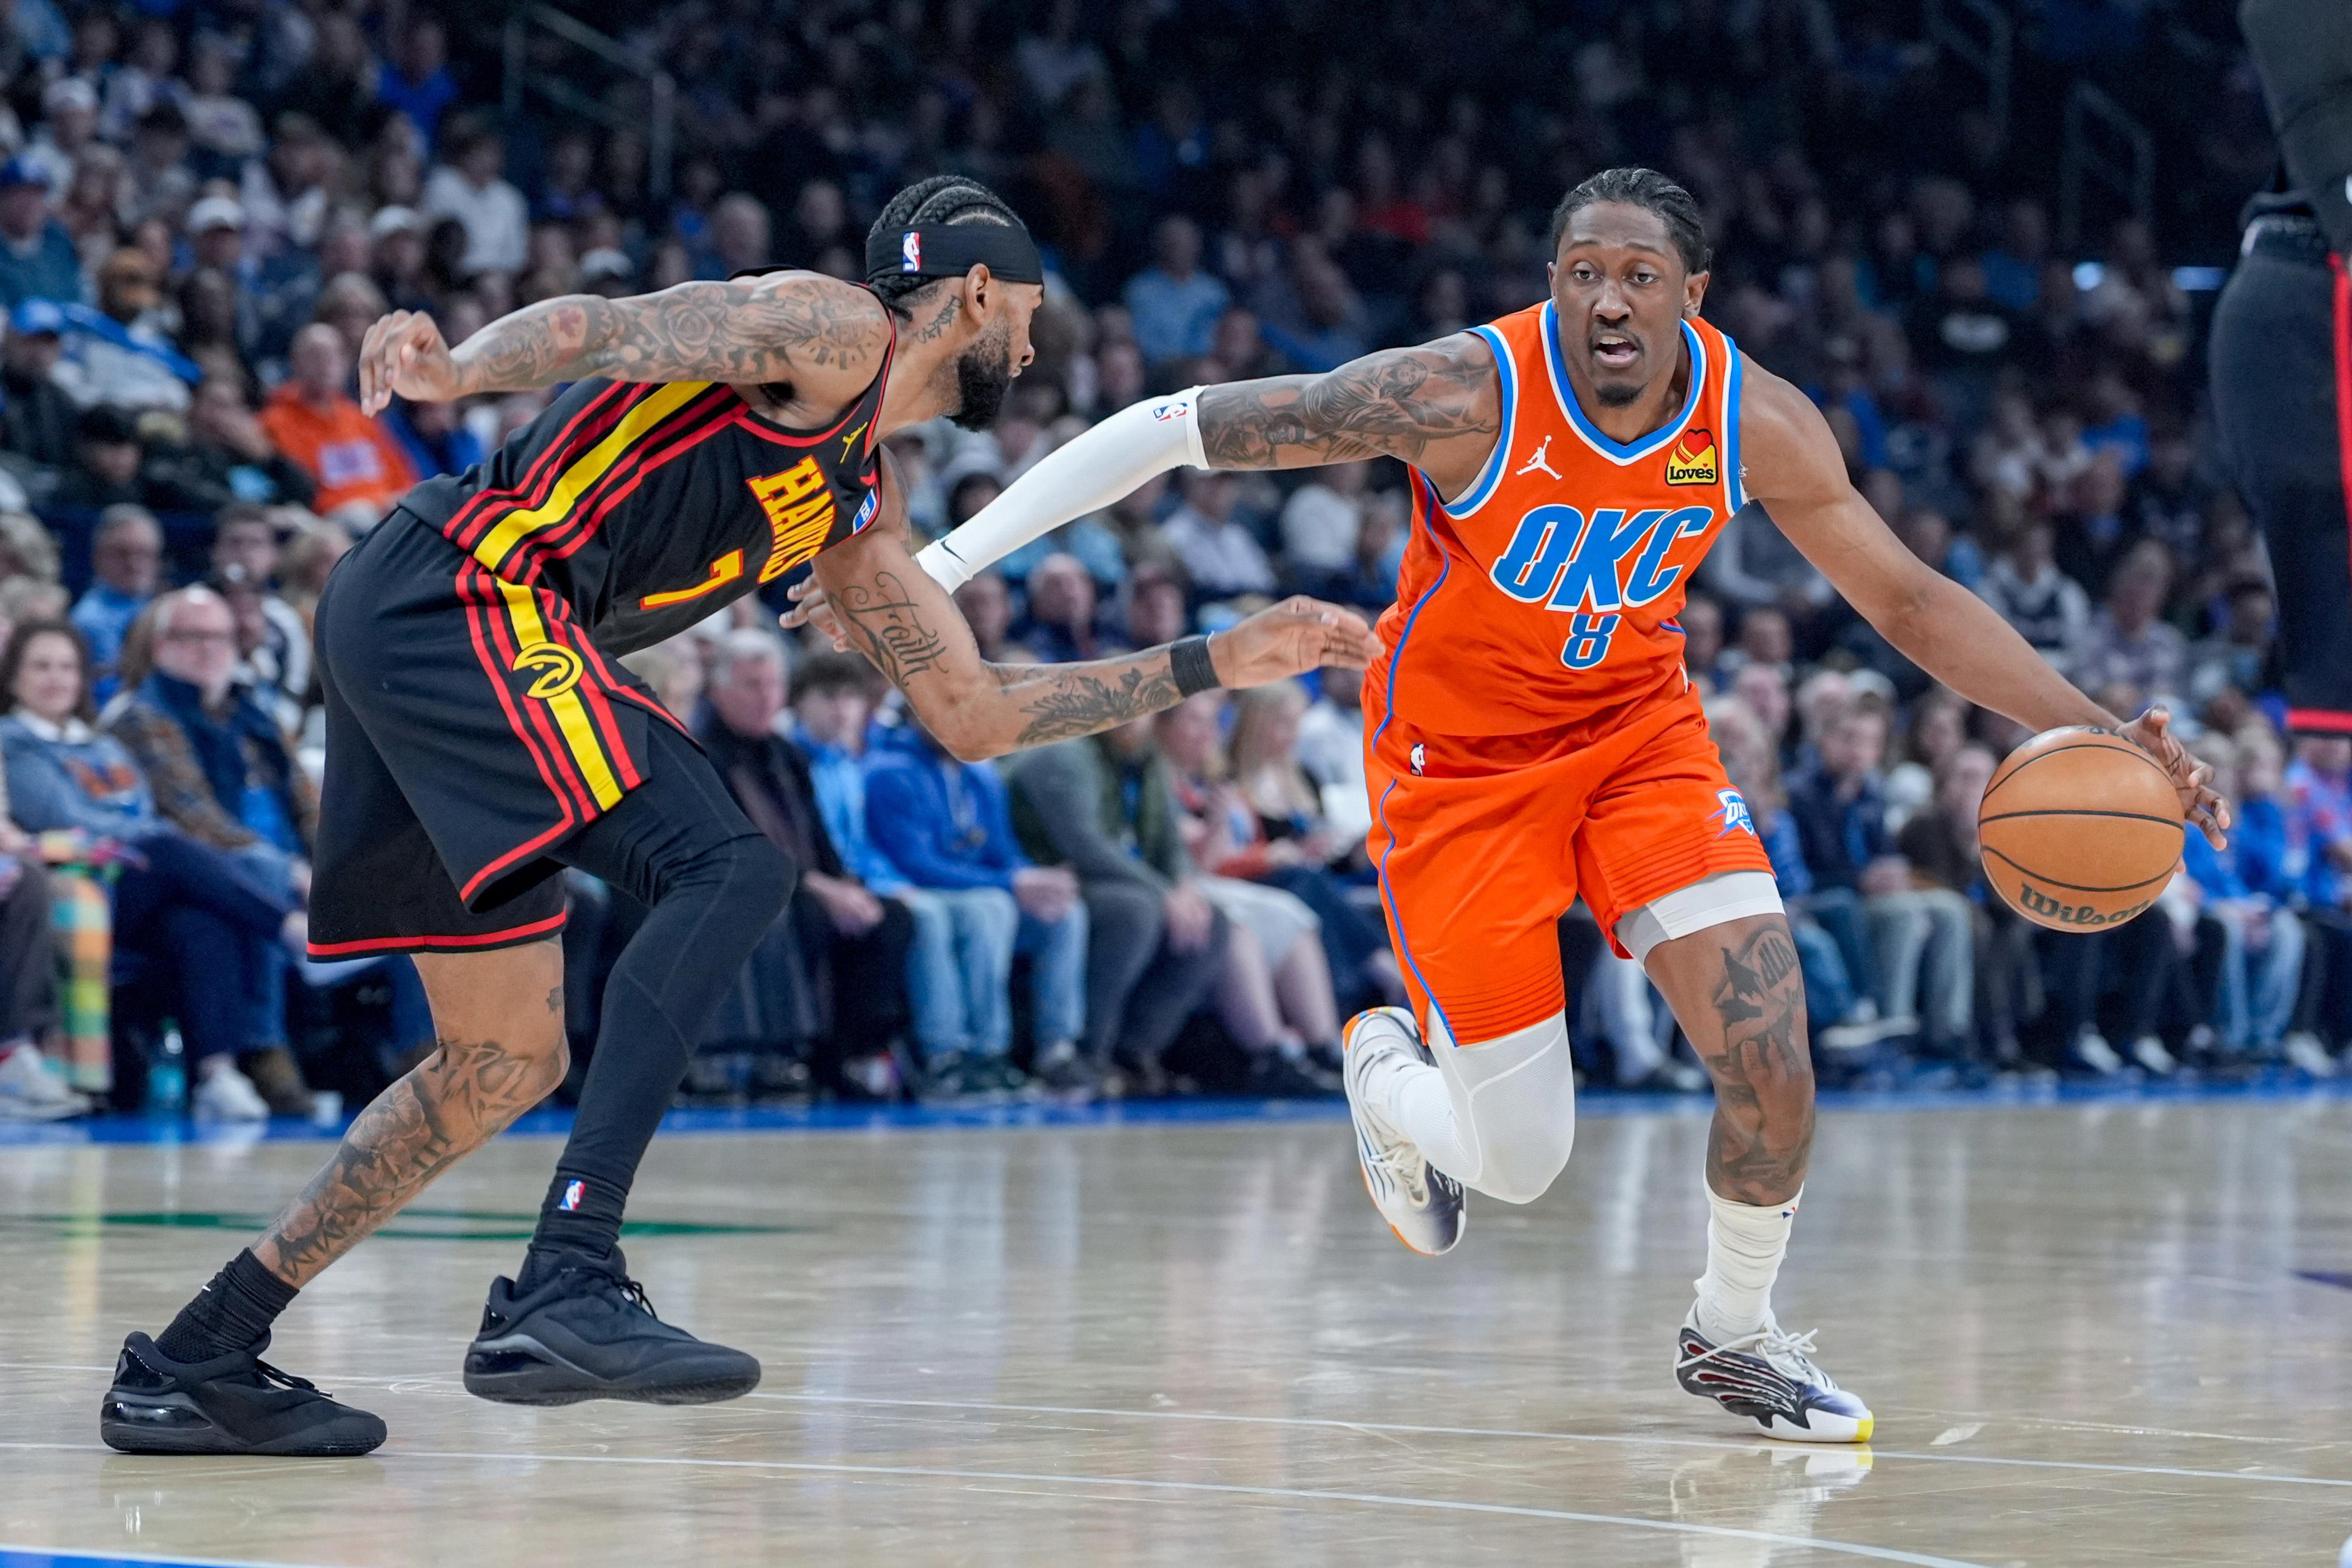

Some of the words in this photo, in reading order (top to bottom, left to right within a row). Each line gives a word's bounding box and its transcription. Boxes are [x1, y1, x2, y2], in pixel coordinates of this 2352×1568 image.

[746, 454, 837, 584] HAWKS
[1489, 503, 1715, 613] OKC
[1560, 613, 1622, 670] 8
[2020, 881, 2150, 925] Wilson
